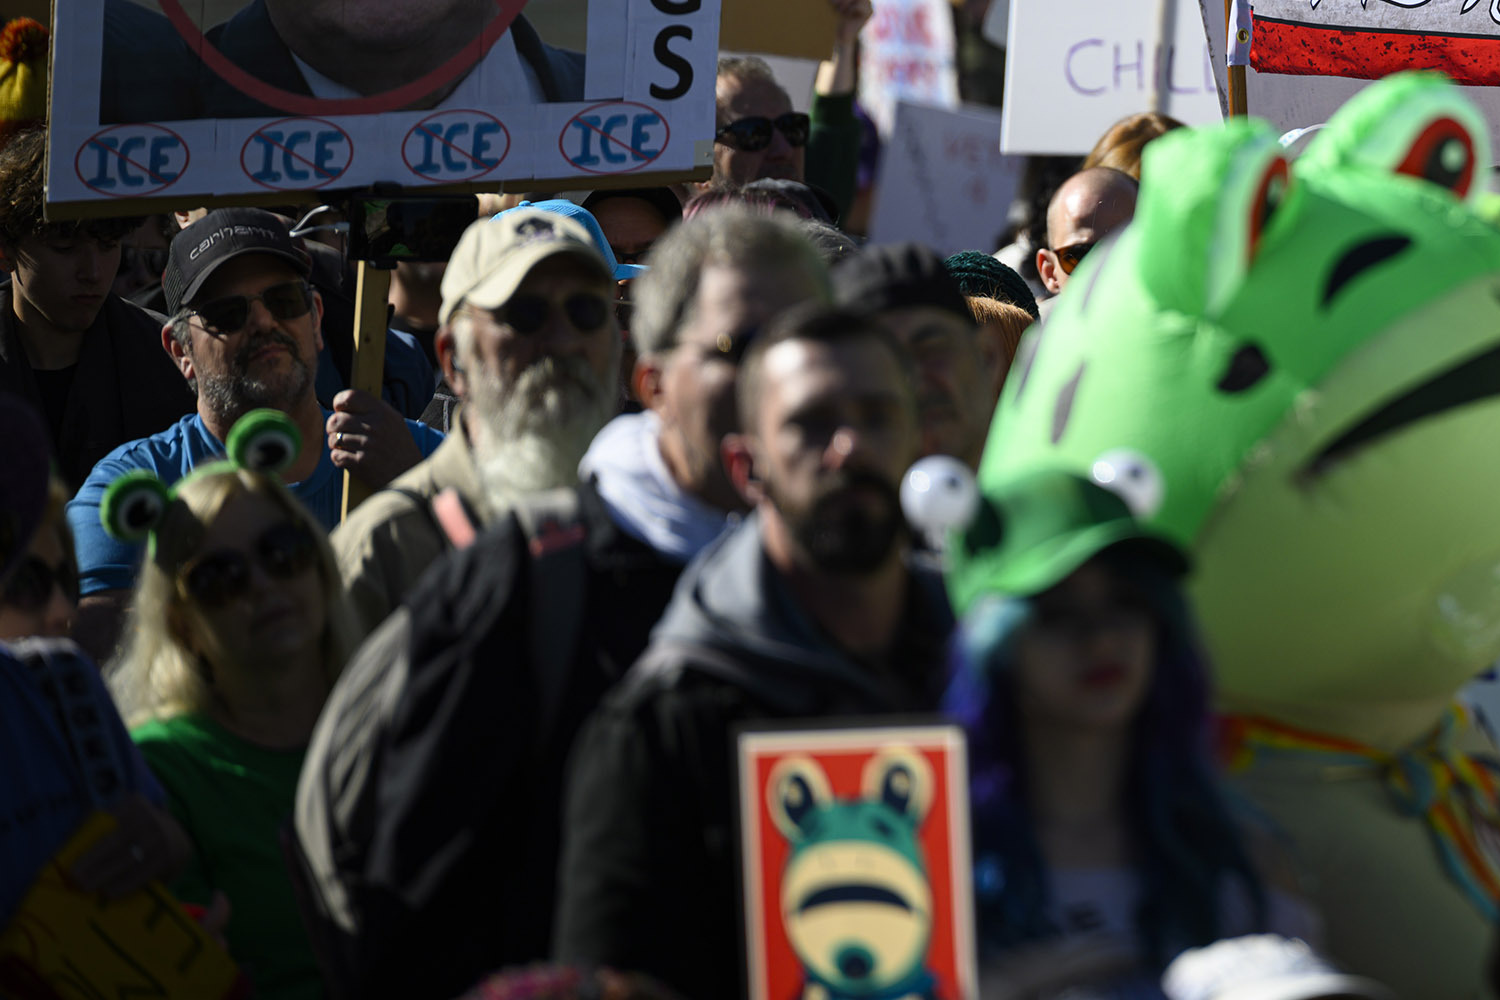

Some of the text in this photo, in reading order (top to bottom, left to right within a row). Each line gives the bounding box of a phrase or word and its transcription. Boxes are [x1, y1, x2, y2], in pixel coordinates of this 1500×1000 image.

[86, 135, 181, 189] ICE
[253, 129, 346, 183] ICE
[412, 121, 504, 177] ICE
[570, 111, 662, 167] ICE
